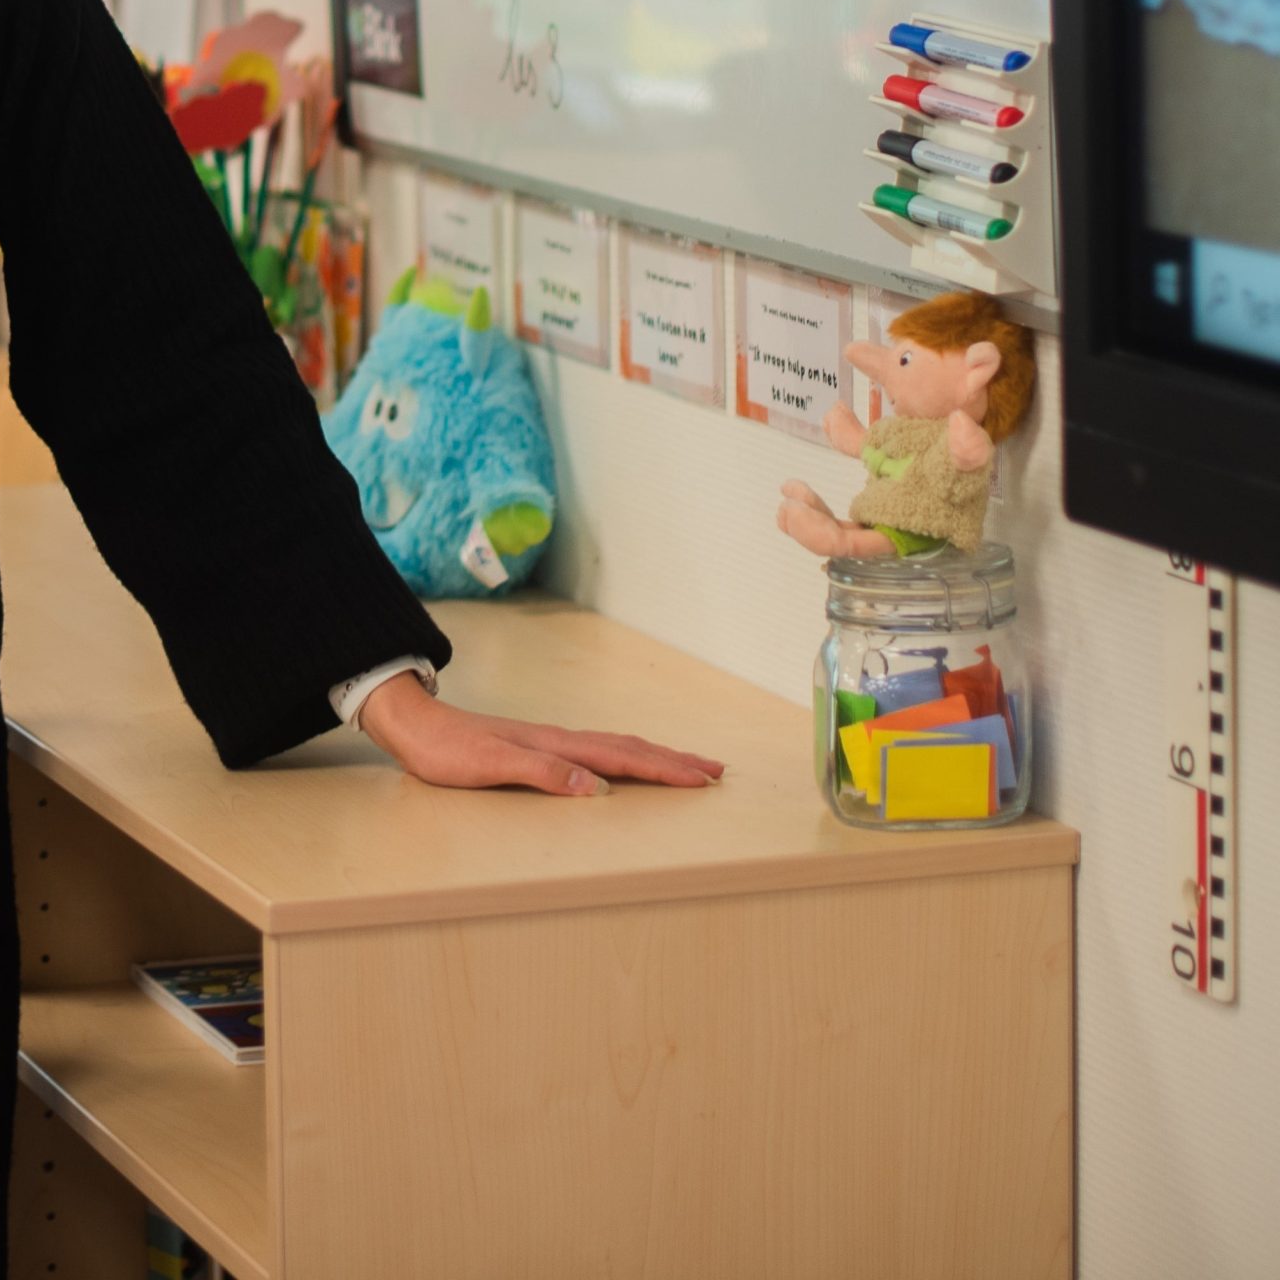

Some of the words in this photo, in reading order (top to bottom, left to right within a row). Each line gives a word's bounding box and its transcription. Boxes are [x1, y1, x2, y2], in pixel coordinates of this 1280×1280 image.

[788, 357, 805, 381] hulp
[808, 368, 821, 382] om
[822, 368, 838, 389] het
[772, 384, 781, 401] te
[1170, 743, 1195, 779] 9
[1171, 918, 1197, 982] 10
